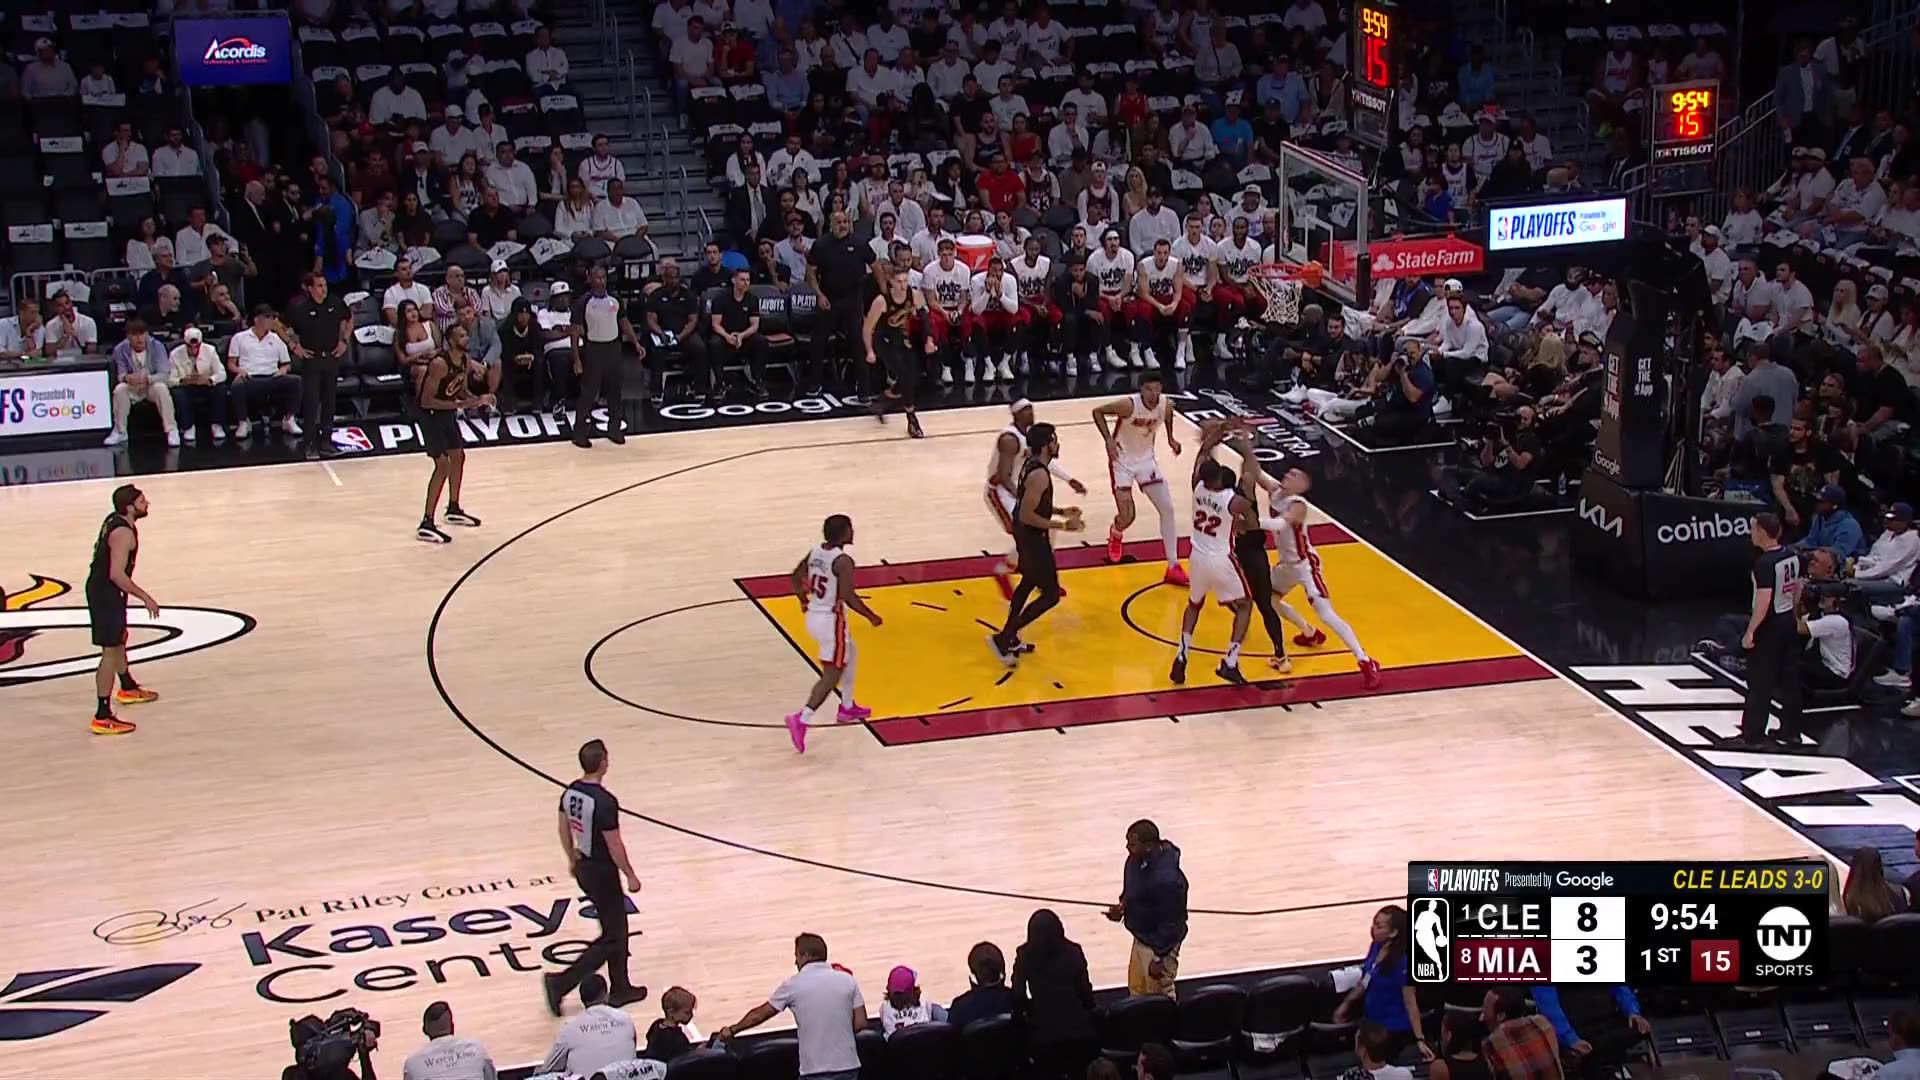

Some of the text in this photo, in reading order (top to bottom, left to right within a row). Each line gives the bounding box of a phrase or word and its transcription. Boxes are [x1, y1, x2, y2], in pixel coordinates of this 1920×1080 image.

[1363, 8, 1388, 39] 9:54
[204, 38, 266, 59] Acordis
[1367, 36, 1388, 87] 15
[1672, 91, 1709, 112] 9:54
[1680, 112, 1699, 135] 15
[1672, 144, 1714, 157] TISSOT
[1510, 211, 1577, 240] PLAYOFFS
[1579, 221, 1617, 232] Gogle
[759, 298, 785, 311] LAYOFFS
[32, 400, 96, 419] Google
[379, 408, 628, 449] PAYOFS
[1595, 450, 1620, 475] Google
[1194, 510, 1222, 537] 22
[1579, 497, 1623, 538] KIA
[1657, 512, 1754, 543] coinba
[256, 905, 311, 923] Pat
[322, 893, 410, 914] Riley
[422, 877, 519, 900] Court
[529, 875, 558, 887] at
[241, 895, 640, 966] Kaseya
[256, 931, 643, 1003] Cente
